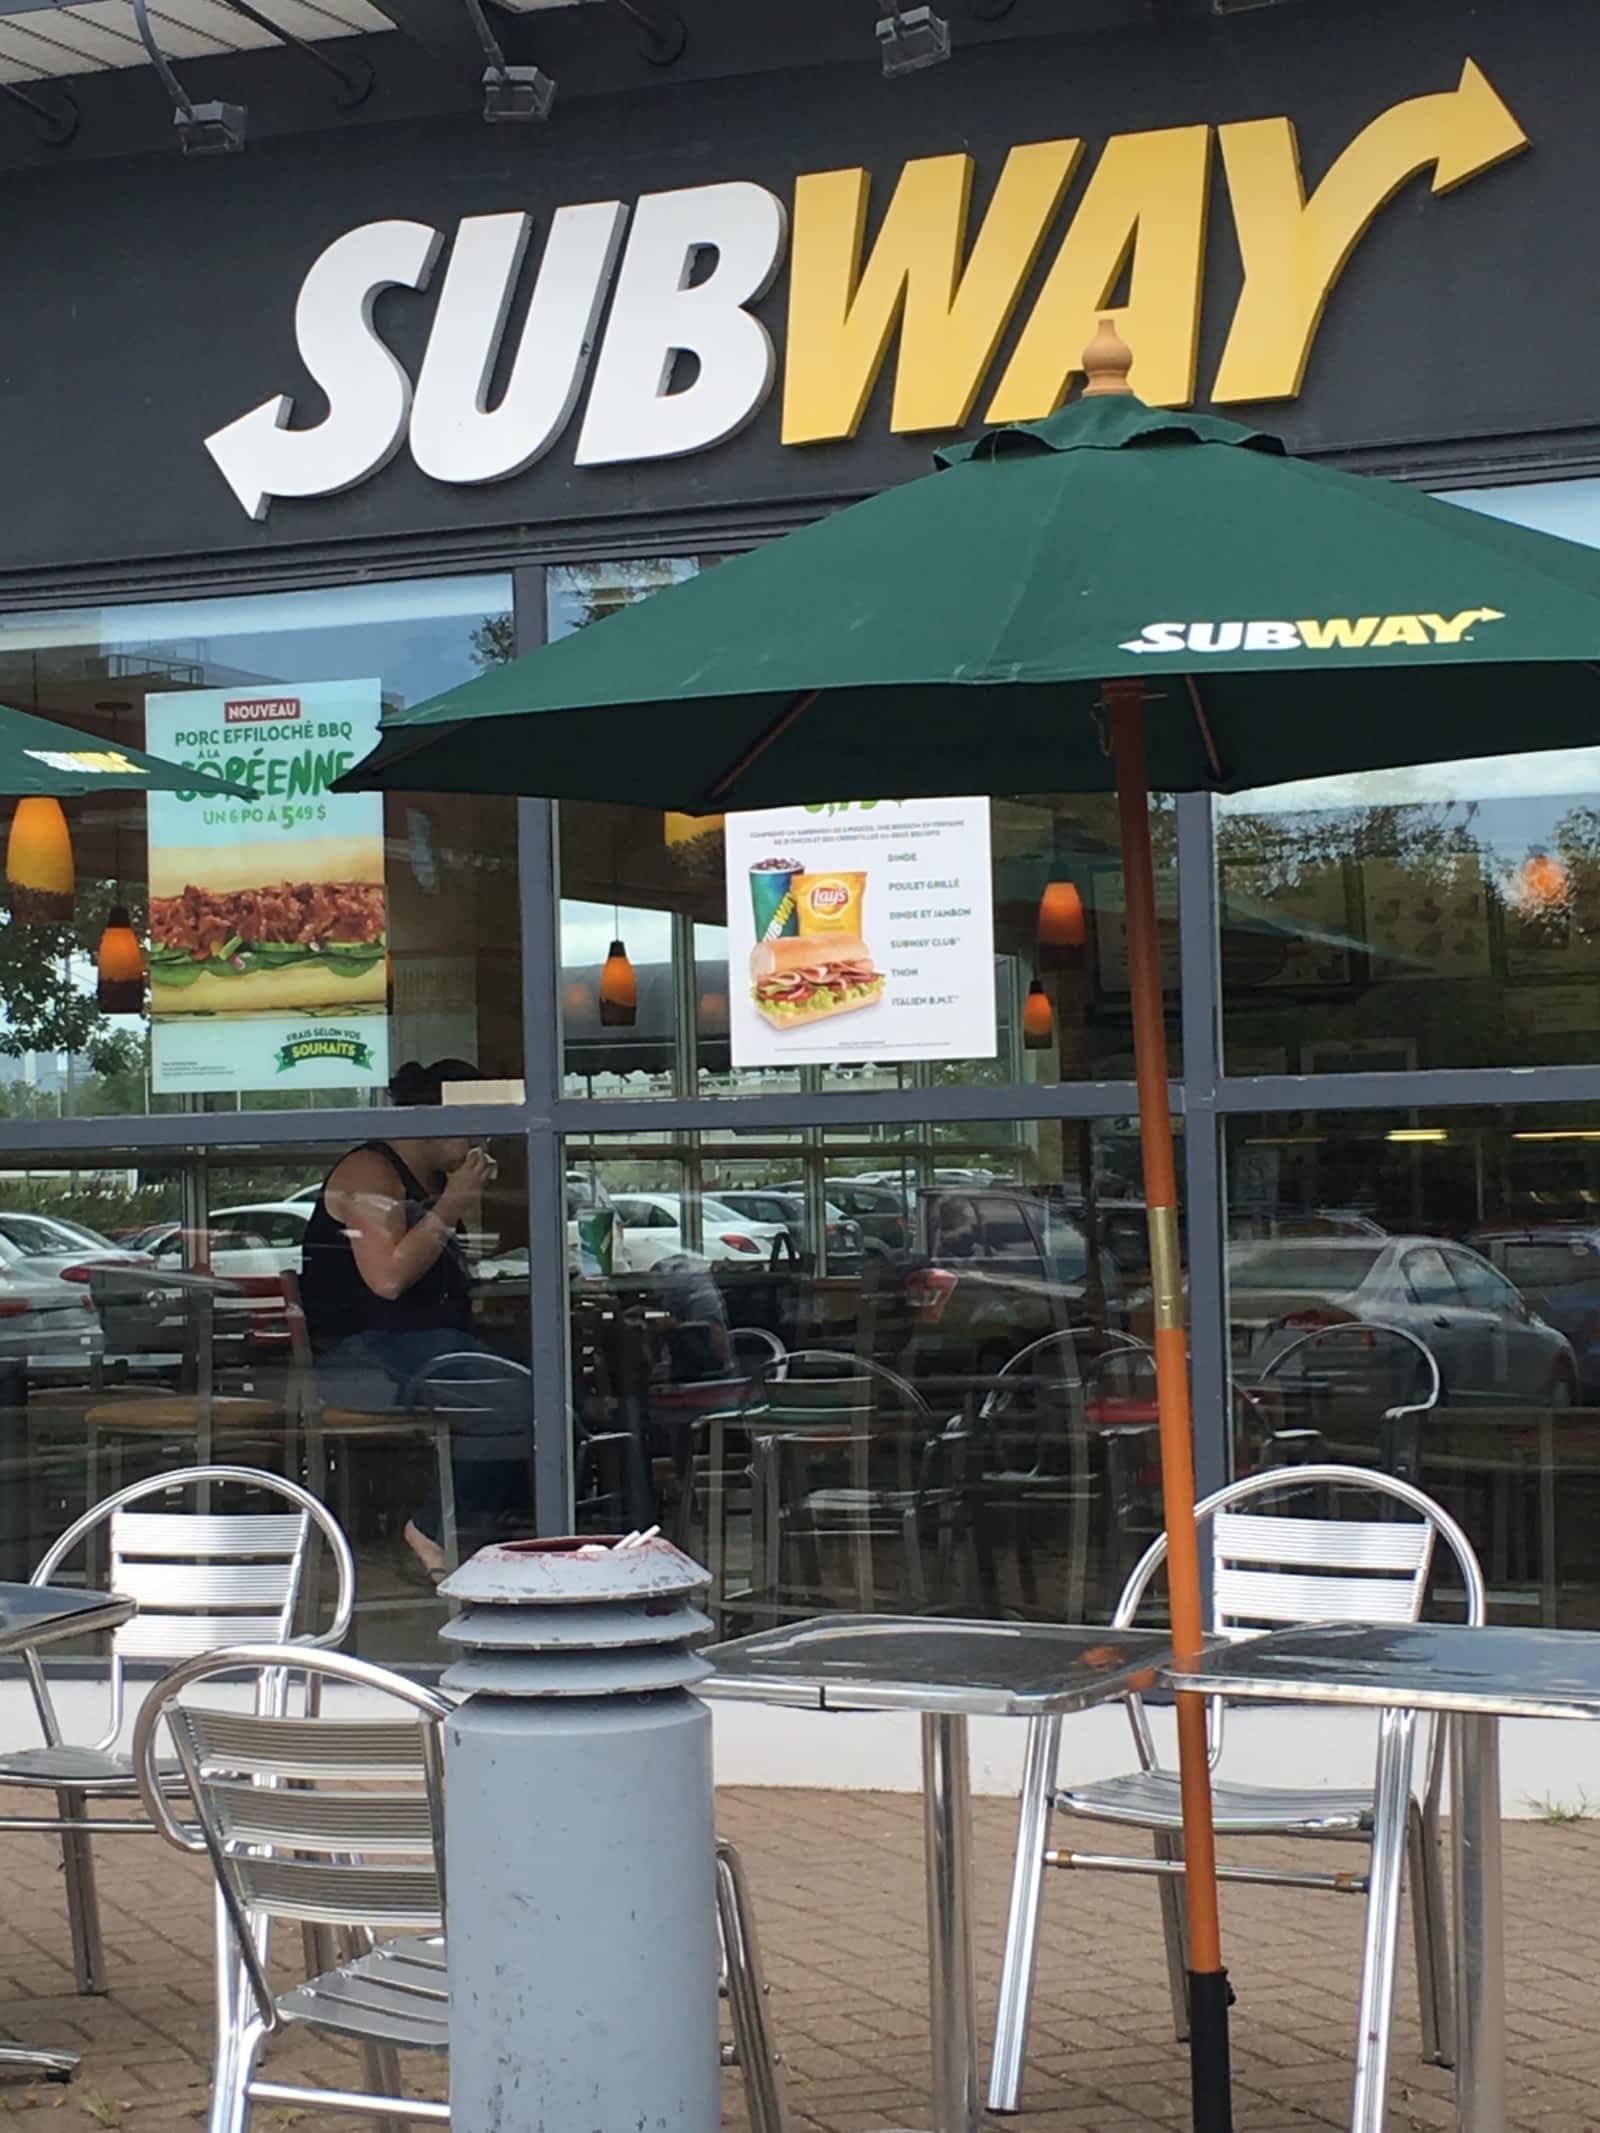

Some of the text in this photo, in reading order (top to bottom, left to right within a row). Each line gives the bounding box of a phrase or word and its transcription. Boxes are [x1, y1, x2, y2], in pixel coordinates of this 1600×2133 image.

[204, 57, 1530, 521] SUBWAY
[1117, 607, 1505, 654] SUBWAY
[228, 702, 297, 720] NOUVEAU
[175, 720, 353, 747] PORC EFFILOCHÉ BBQ
[203, 809, 226, 825] UN
[241, 807, 264, 823] PO
[888, 880, 925, 890] POULET
[920, 909, 931, 919] ET
[291, 1041, 357, 1058] SOUHAITS
